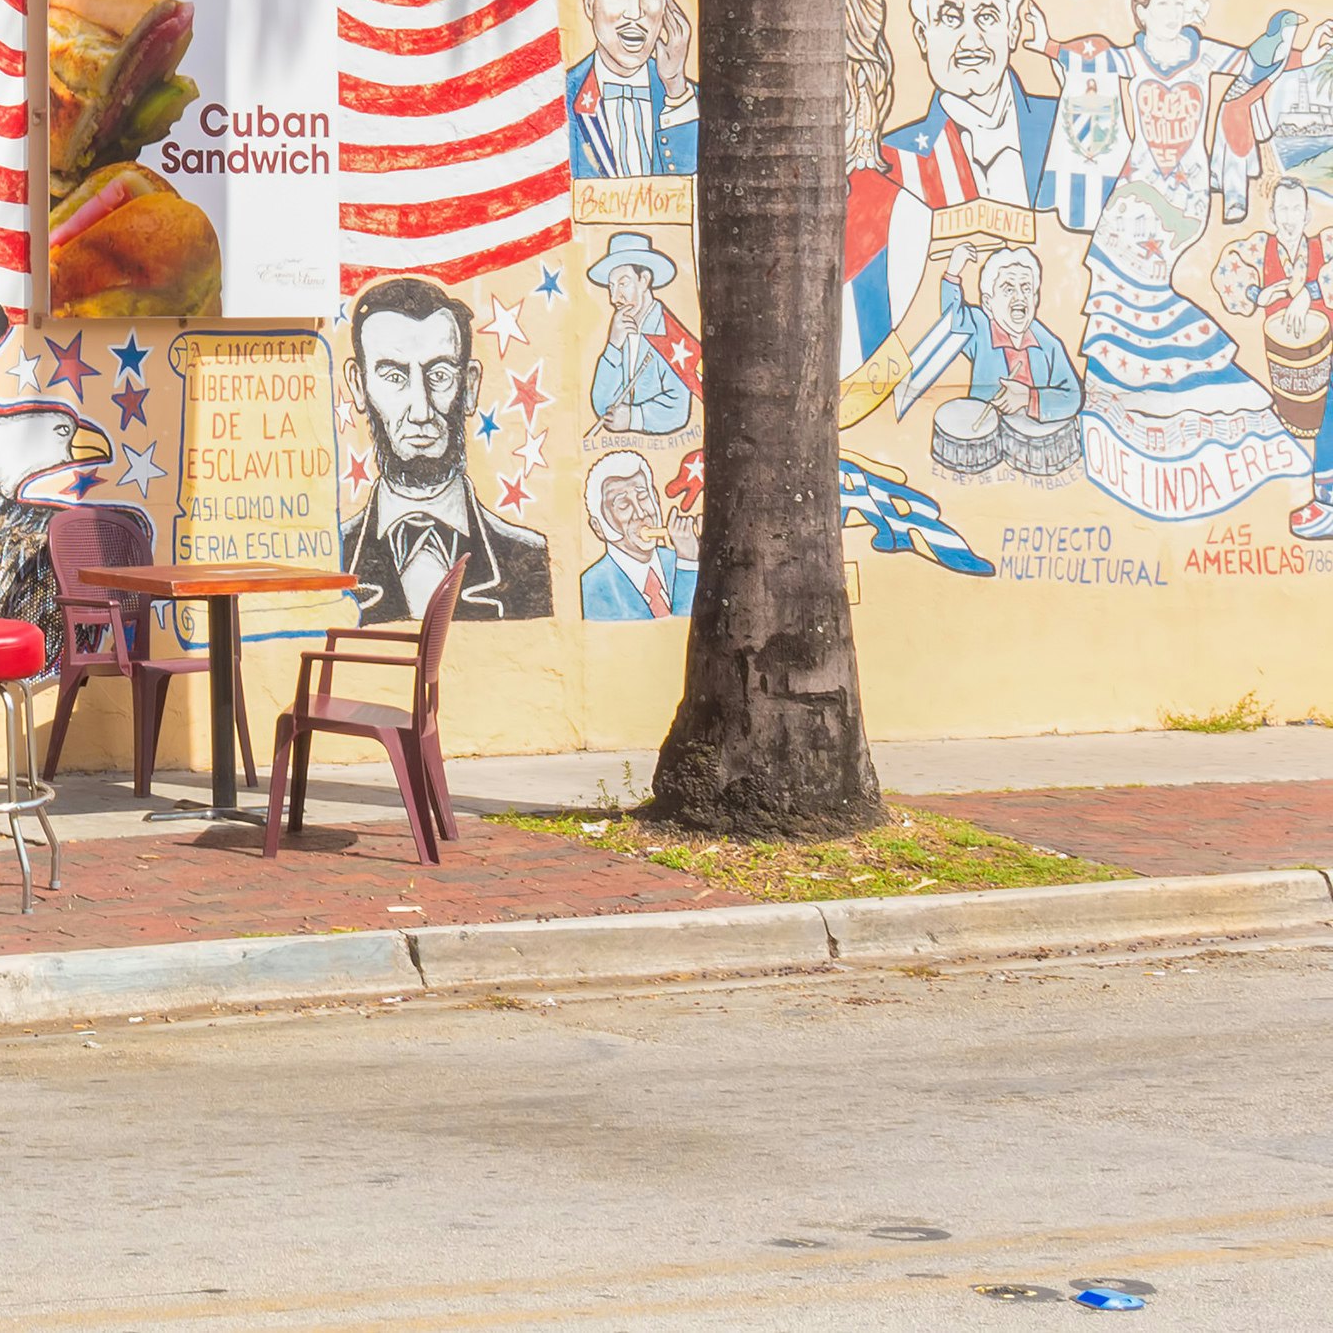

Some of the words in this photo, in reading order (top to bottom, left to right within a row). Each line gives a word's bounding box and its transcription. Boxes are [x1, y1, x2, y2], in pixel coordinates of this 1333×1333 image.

[200, 104, 330, 139] Cuban
[161, 142, 330, 175] Sandwich
[937, 207, 973, 233] TITO
[977, 203, 1031, 237] PUENTE
[214, 339, 313, 367] LINCOLN
[189, 374, 316, 402] LIBERTADOR
[212, 412, 241, 441] DE
[263, 412, 297, 440] LA
[583, 439, 599, 451] EL
[668, 424, 702, 447] RITMO
[187, 448, 332, 482] ESCLAVITUD
[932, 464, 947, 480] EL
[978, 473, 992, 485] DE
[997, 468, 1016, 482] LOS
[1021, 464, 1085, 491] TIMBALES
[1086, 425, 1133, 499] QUE
[1139, 460, 1221, 512] LINDA
[1225, 439, 1295, 494] ERES
[225, 495, 274, 521] COMO
[280, 492, 310, 518] NO
[180, 535, 239, 562] SERIA
[247, 530, 333, 560] ESCLAVO
[1001, 525, 1112, 553] PROYECTO
[1206, 524, 1252, 546] LAS
[999, 555, 1169, 587] MULTICULTURAL
[1184, 544, 1305, 575] AMERICAS
